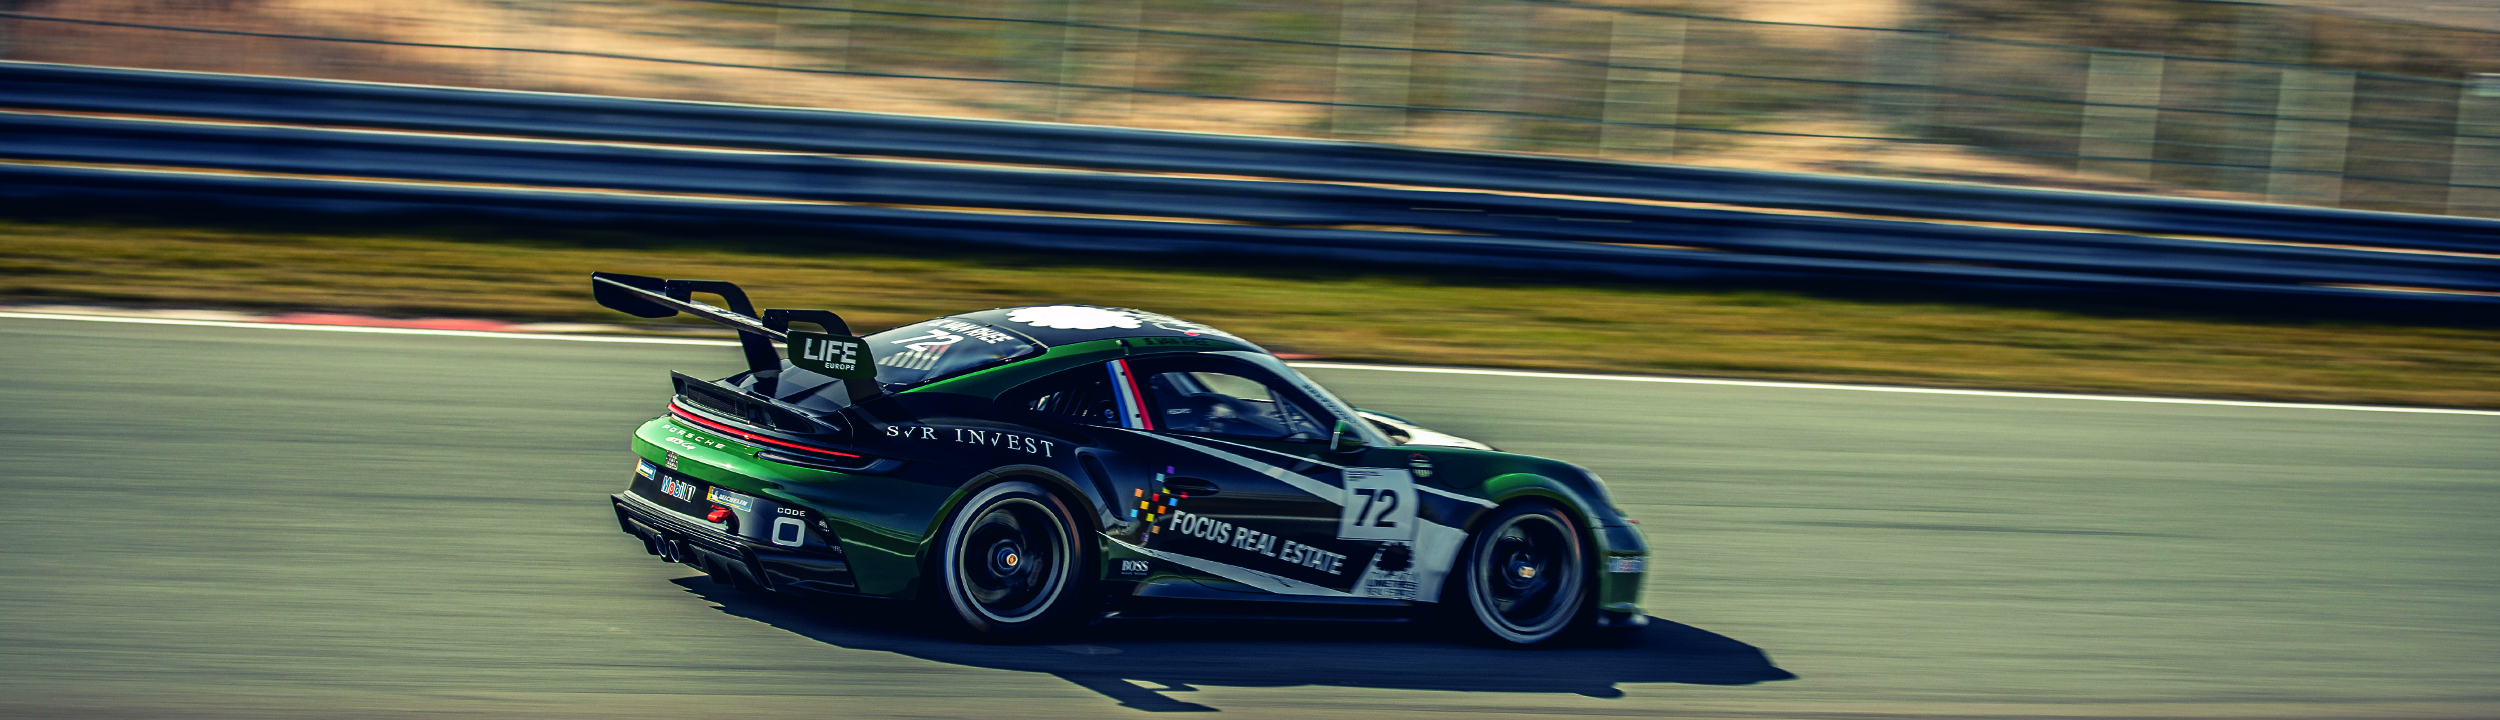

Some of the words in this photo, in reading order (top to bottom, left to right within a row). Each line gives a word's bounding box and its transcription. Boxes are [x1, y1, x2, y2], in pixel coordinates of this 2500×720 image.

[803, 338, 859, 364] LIFE
[890, 328, 964, 352] 72
[824, 362, 855, 371] EUROPE
[661, 424, 726, 449] PORSCHE
[660, 474, 687, 499] Mobil
[684, 484, 696, 503] 1
[718, 494, 749, 507] MICHELIN
[777, 507, 806, 517] CODE
[1352, 488, 1399, 528] 72
[1169, 509, 1232, 544] FOCUS
[1231, 526, 1277, 557] REAL
[1278, 539, 1347, 576] ESTATE
[1121, 560, 1149, 571] BOSS
